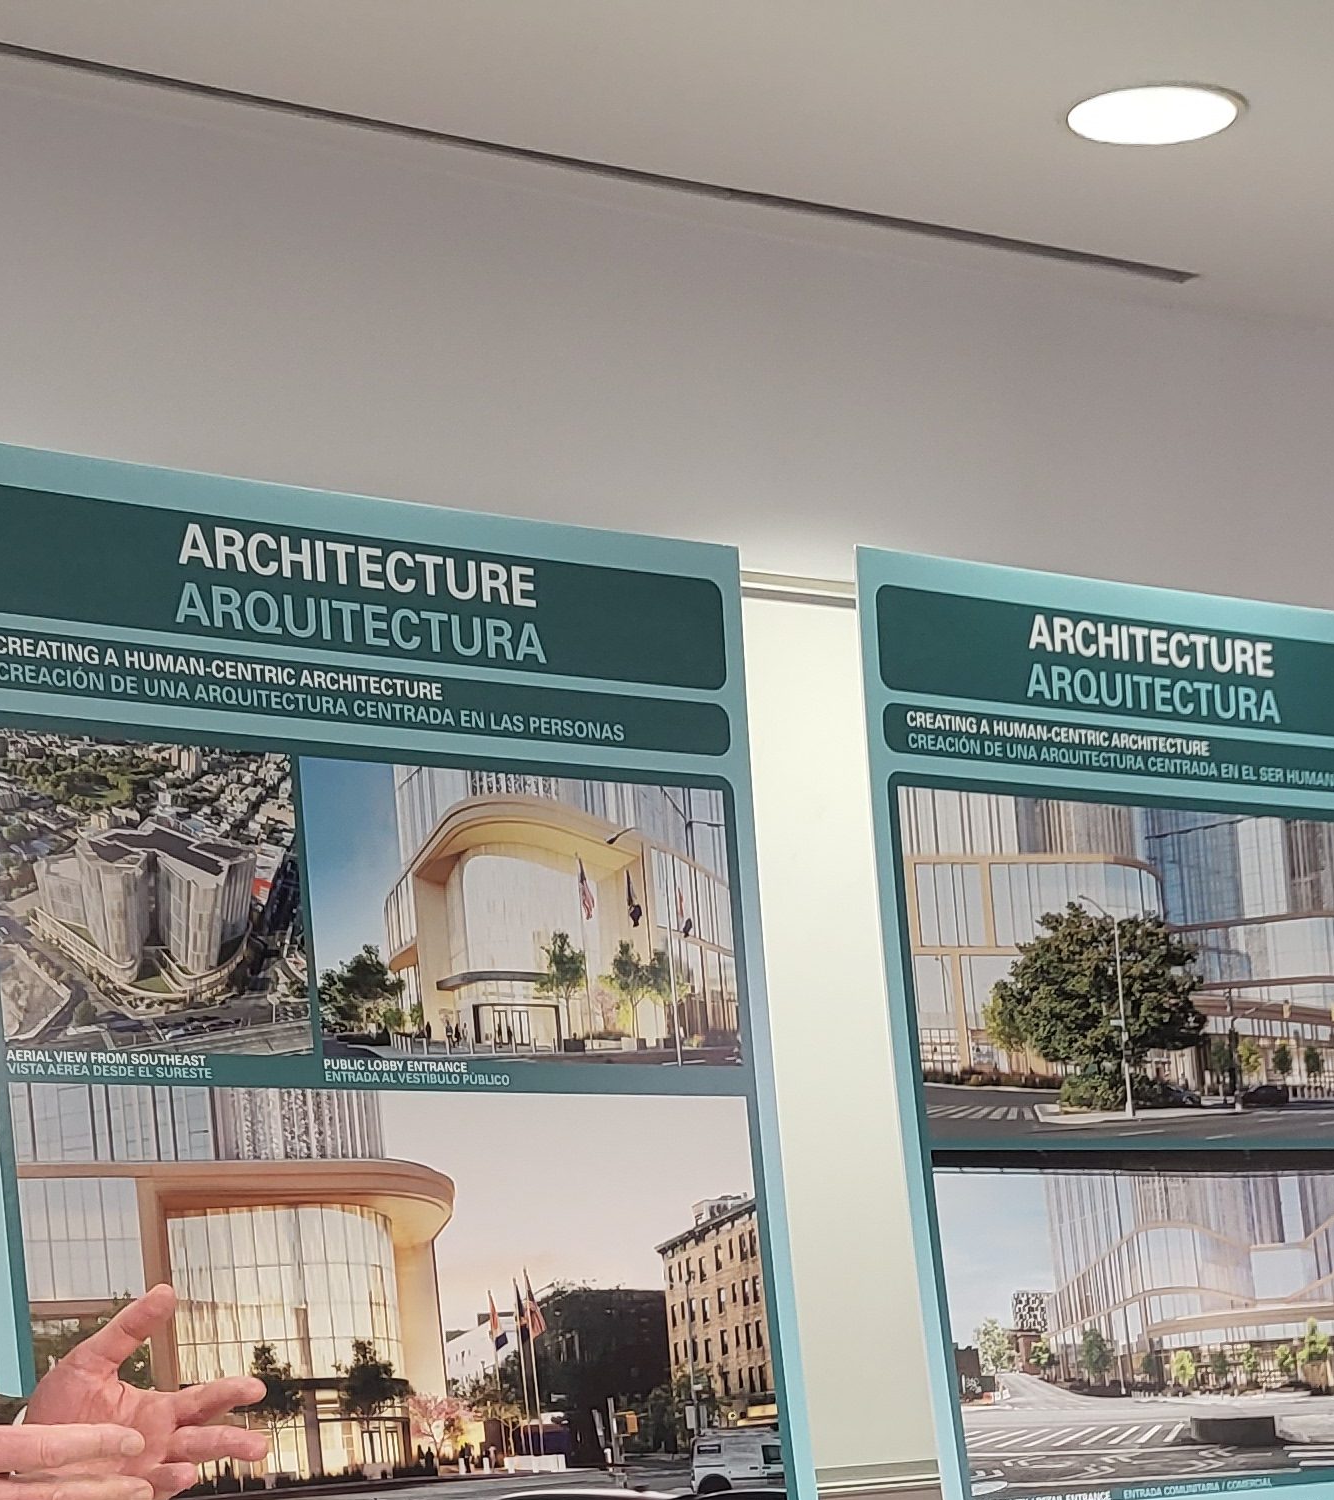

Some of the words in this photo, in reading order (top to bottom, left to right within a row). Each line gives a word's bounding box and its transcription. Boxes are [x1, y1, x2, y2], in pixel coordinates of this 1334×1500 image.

[178, 523, 536, 607] ARCHITECTURE
[175, 582, 547, 664] ARQUITECTURA
[1028, 614, 1275, 678] ARCHITECTURE
[104, 647, 119, 667] A
[124, 649, 295, 685] HUMAN-CENTRIC
[299, 669, 443, 700] ARCHITECTURE
[1027, 663, 1280, 723] ARQUITECTURA
[110, 674, 138, 694] DE
[143, 677, 190, 700] UNA
[194, 683, 348, 716] ARQUITECTURA
[353, 699, 455, 726] CENTRADA
[460, 709, 486, 728] EN
[490, 712, 524, 732] LAS
[529, 716, 624, 741] PERSONAS
[905, 710, 977, 733] CREATING
[979, 718, 990, 734] A
[993, 720, 1109, 748] HUMAN-CENTRIC
[1111, 731, 1211, 755] ARCHITECTURE
[907, 733, 980, 754] CREACIÓN
[984, 741, 1003, 756] DE
[1006, 743, 1037, 760] UNA
[1040, 747, 1145, 771] ARQUITECTURA
[1148, 756, 1218, 777] CENTRADA
[1221, 763, 1238, 779] EN
[1242, 765, 1257, 780] EL
[1260, 767, 1284, 783] SER
[5, 1049, 54, 1065] AERIAL
[52, 1050, 89, 1065] VIEW
[88, 1051, 130, 1067] FROM
[129, 1052, 209, 1069] SOUTHEAST
[6, 1062, 47, 1076] VISTA
[91, 1063, 135, 1078] DESDE
[138, 1066, 153, 1079] EL
[154, 1065, 212, 1080] SURESTE
[321, 1056, 369, 1071] PUBLIC
[367, 1058, 408, 1072] LOBBY
[406, 1058, 470, 1074] ENTRANCE
[323, 1070, 382, 1084] ENTRADA
[381, 1071, 397, 1083] AL
[397, 1071, 461, 1084] VESTÍBULO
[461, 1073, 509, 1085] PÚBLICO
